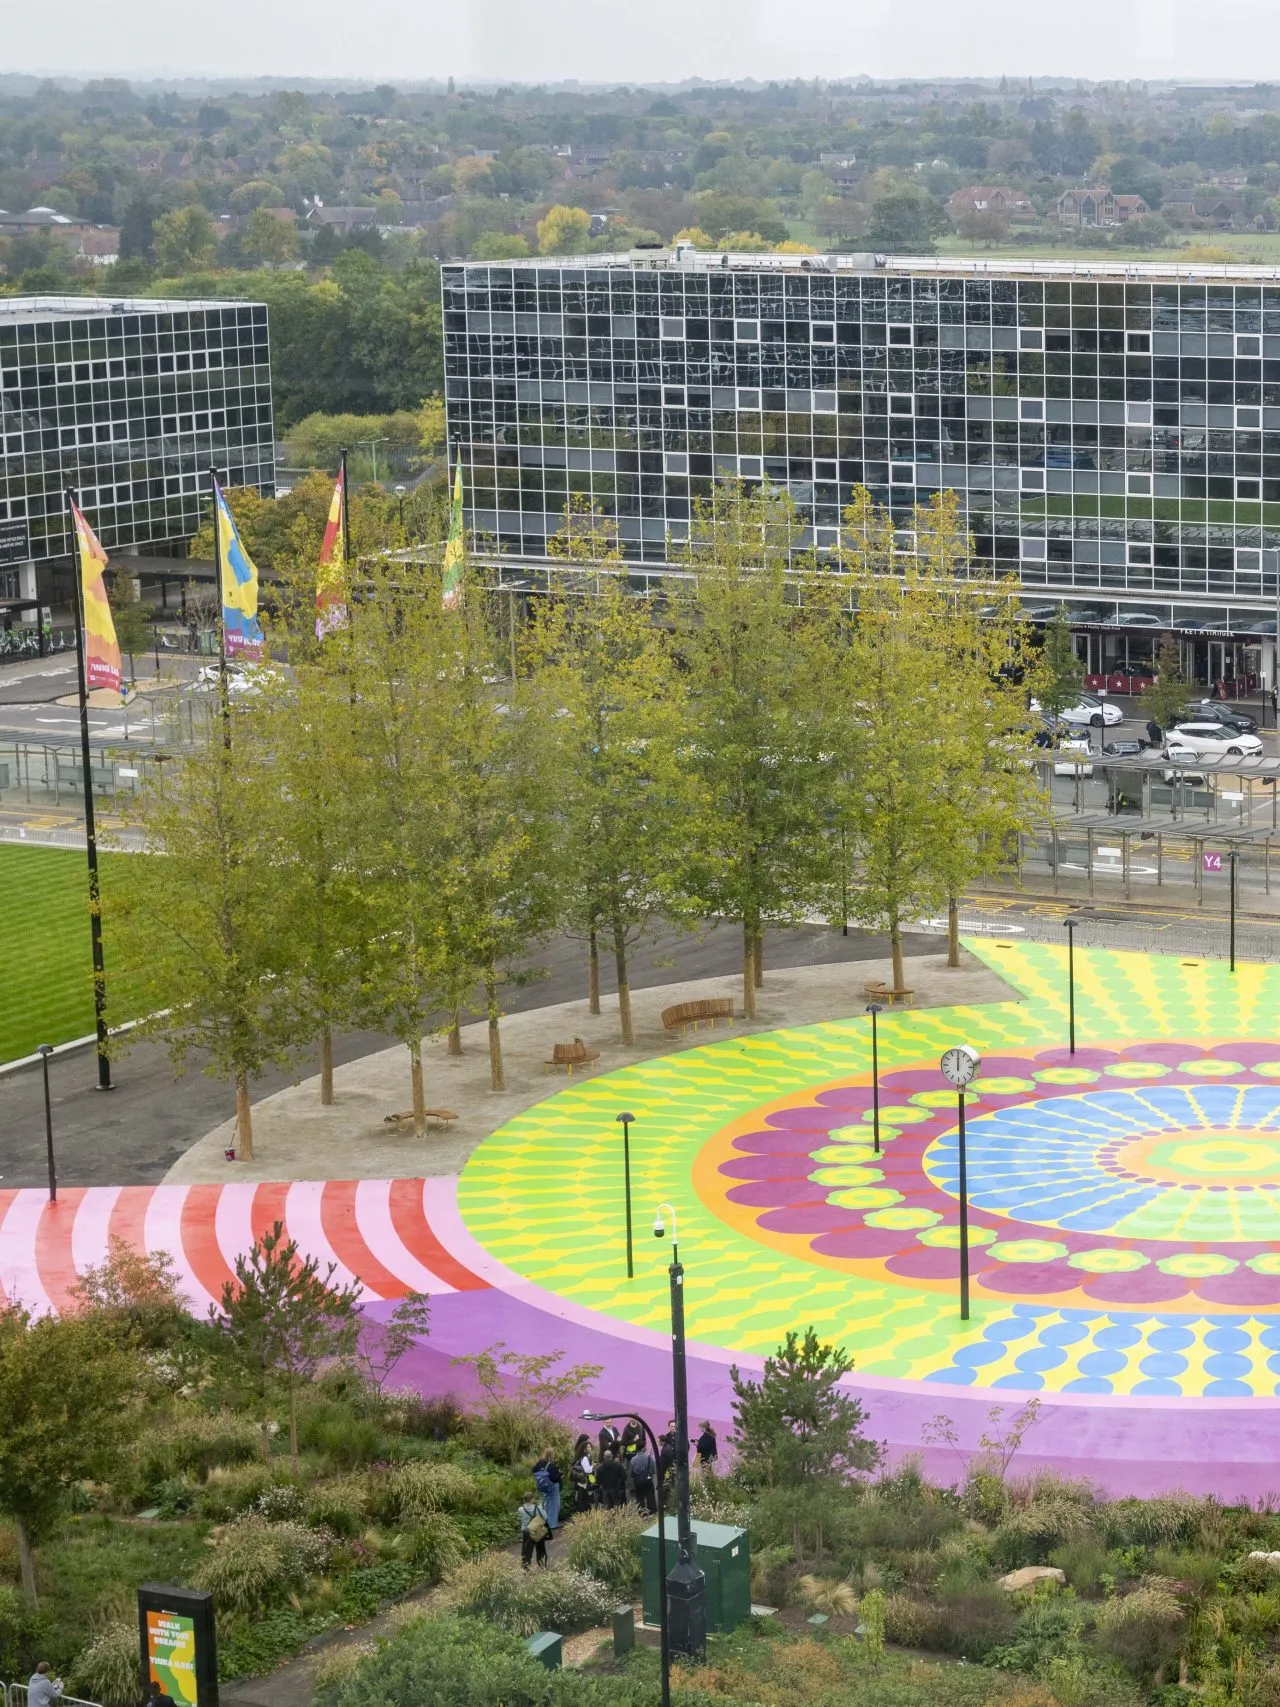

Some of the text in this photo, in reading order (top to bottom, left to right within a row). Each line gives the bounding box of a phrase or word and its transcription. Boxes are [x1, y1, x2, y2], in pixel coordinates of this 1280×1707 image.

[1204, 856, 1222, 868] Y4
[158, 1620, 180, 1630] WALK
[150, 1628, 190, 1641] WITH YOUR
[149, 1656, 172, 1667] YINKA
